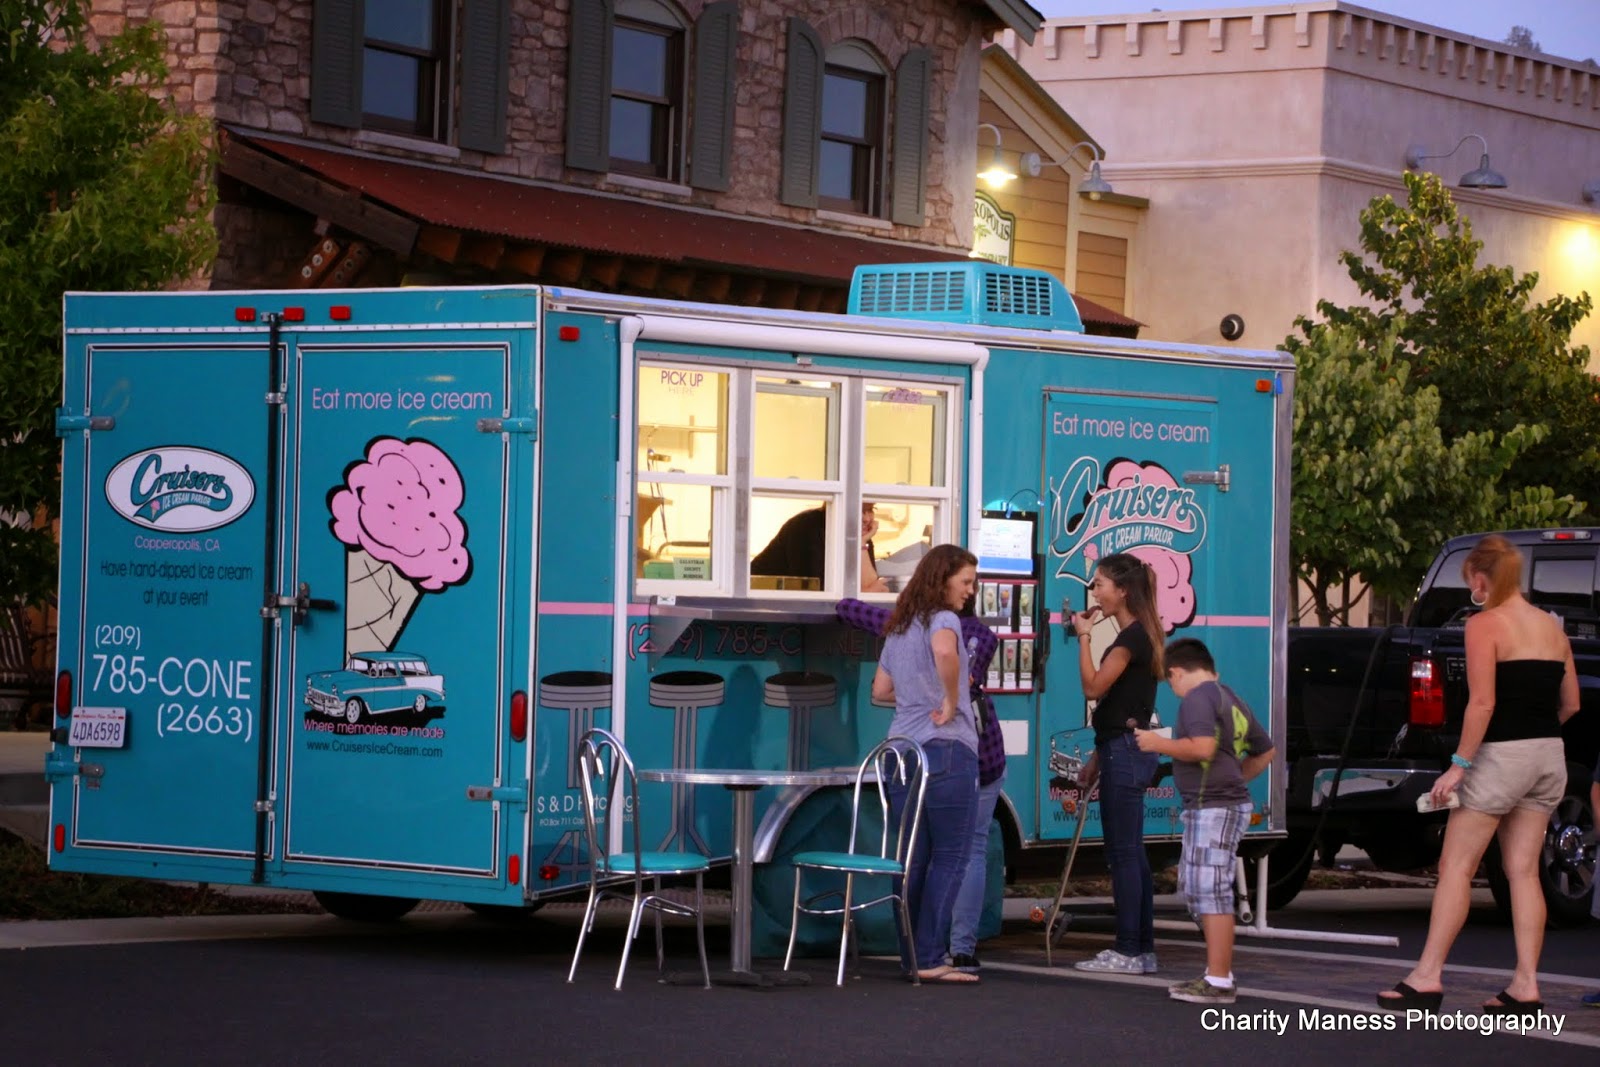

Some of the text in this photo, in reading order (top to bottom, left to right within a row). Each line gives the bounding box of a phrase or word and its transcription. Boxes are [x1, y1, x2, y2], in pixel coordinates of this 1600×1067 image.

[660, 370, 704, 387] PICK UP
[312, 387, 492, 410] Eat more ice cream
[1053, 412, 1210, 443] Eat more ice cream
[130, 453, 234, 512] Cruisers
[162, 493, 211, 511] ICE CREAM PARLOR
[1051, 455, 1207, 557] Cruisers
[205, 538, 220, 551] CA
[1101, 525, 1174, 558] ICE CREAM PARLOR
[101, 559, 253, 580] Have hand-dipped ice cream
[143, 588, 209, 608] at your event
[95, 624, 141, 650] (209)
[628, 623, 704, 661] (29)
[93, 653, 252, 699] 785-CONE
[72, 721, 122, 742] 4DA6598
[157, 703, 253, 743] (2663)
[303, 719, 444, 739] Where memories are made
[537, 796, 545, 813] S
[549, 796, 559, 813] &
[564, 795, 574, 812] D
[1146, 787, 1175, 799] made
